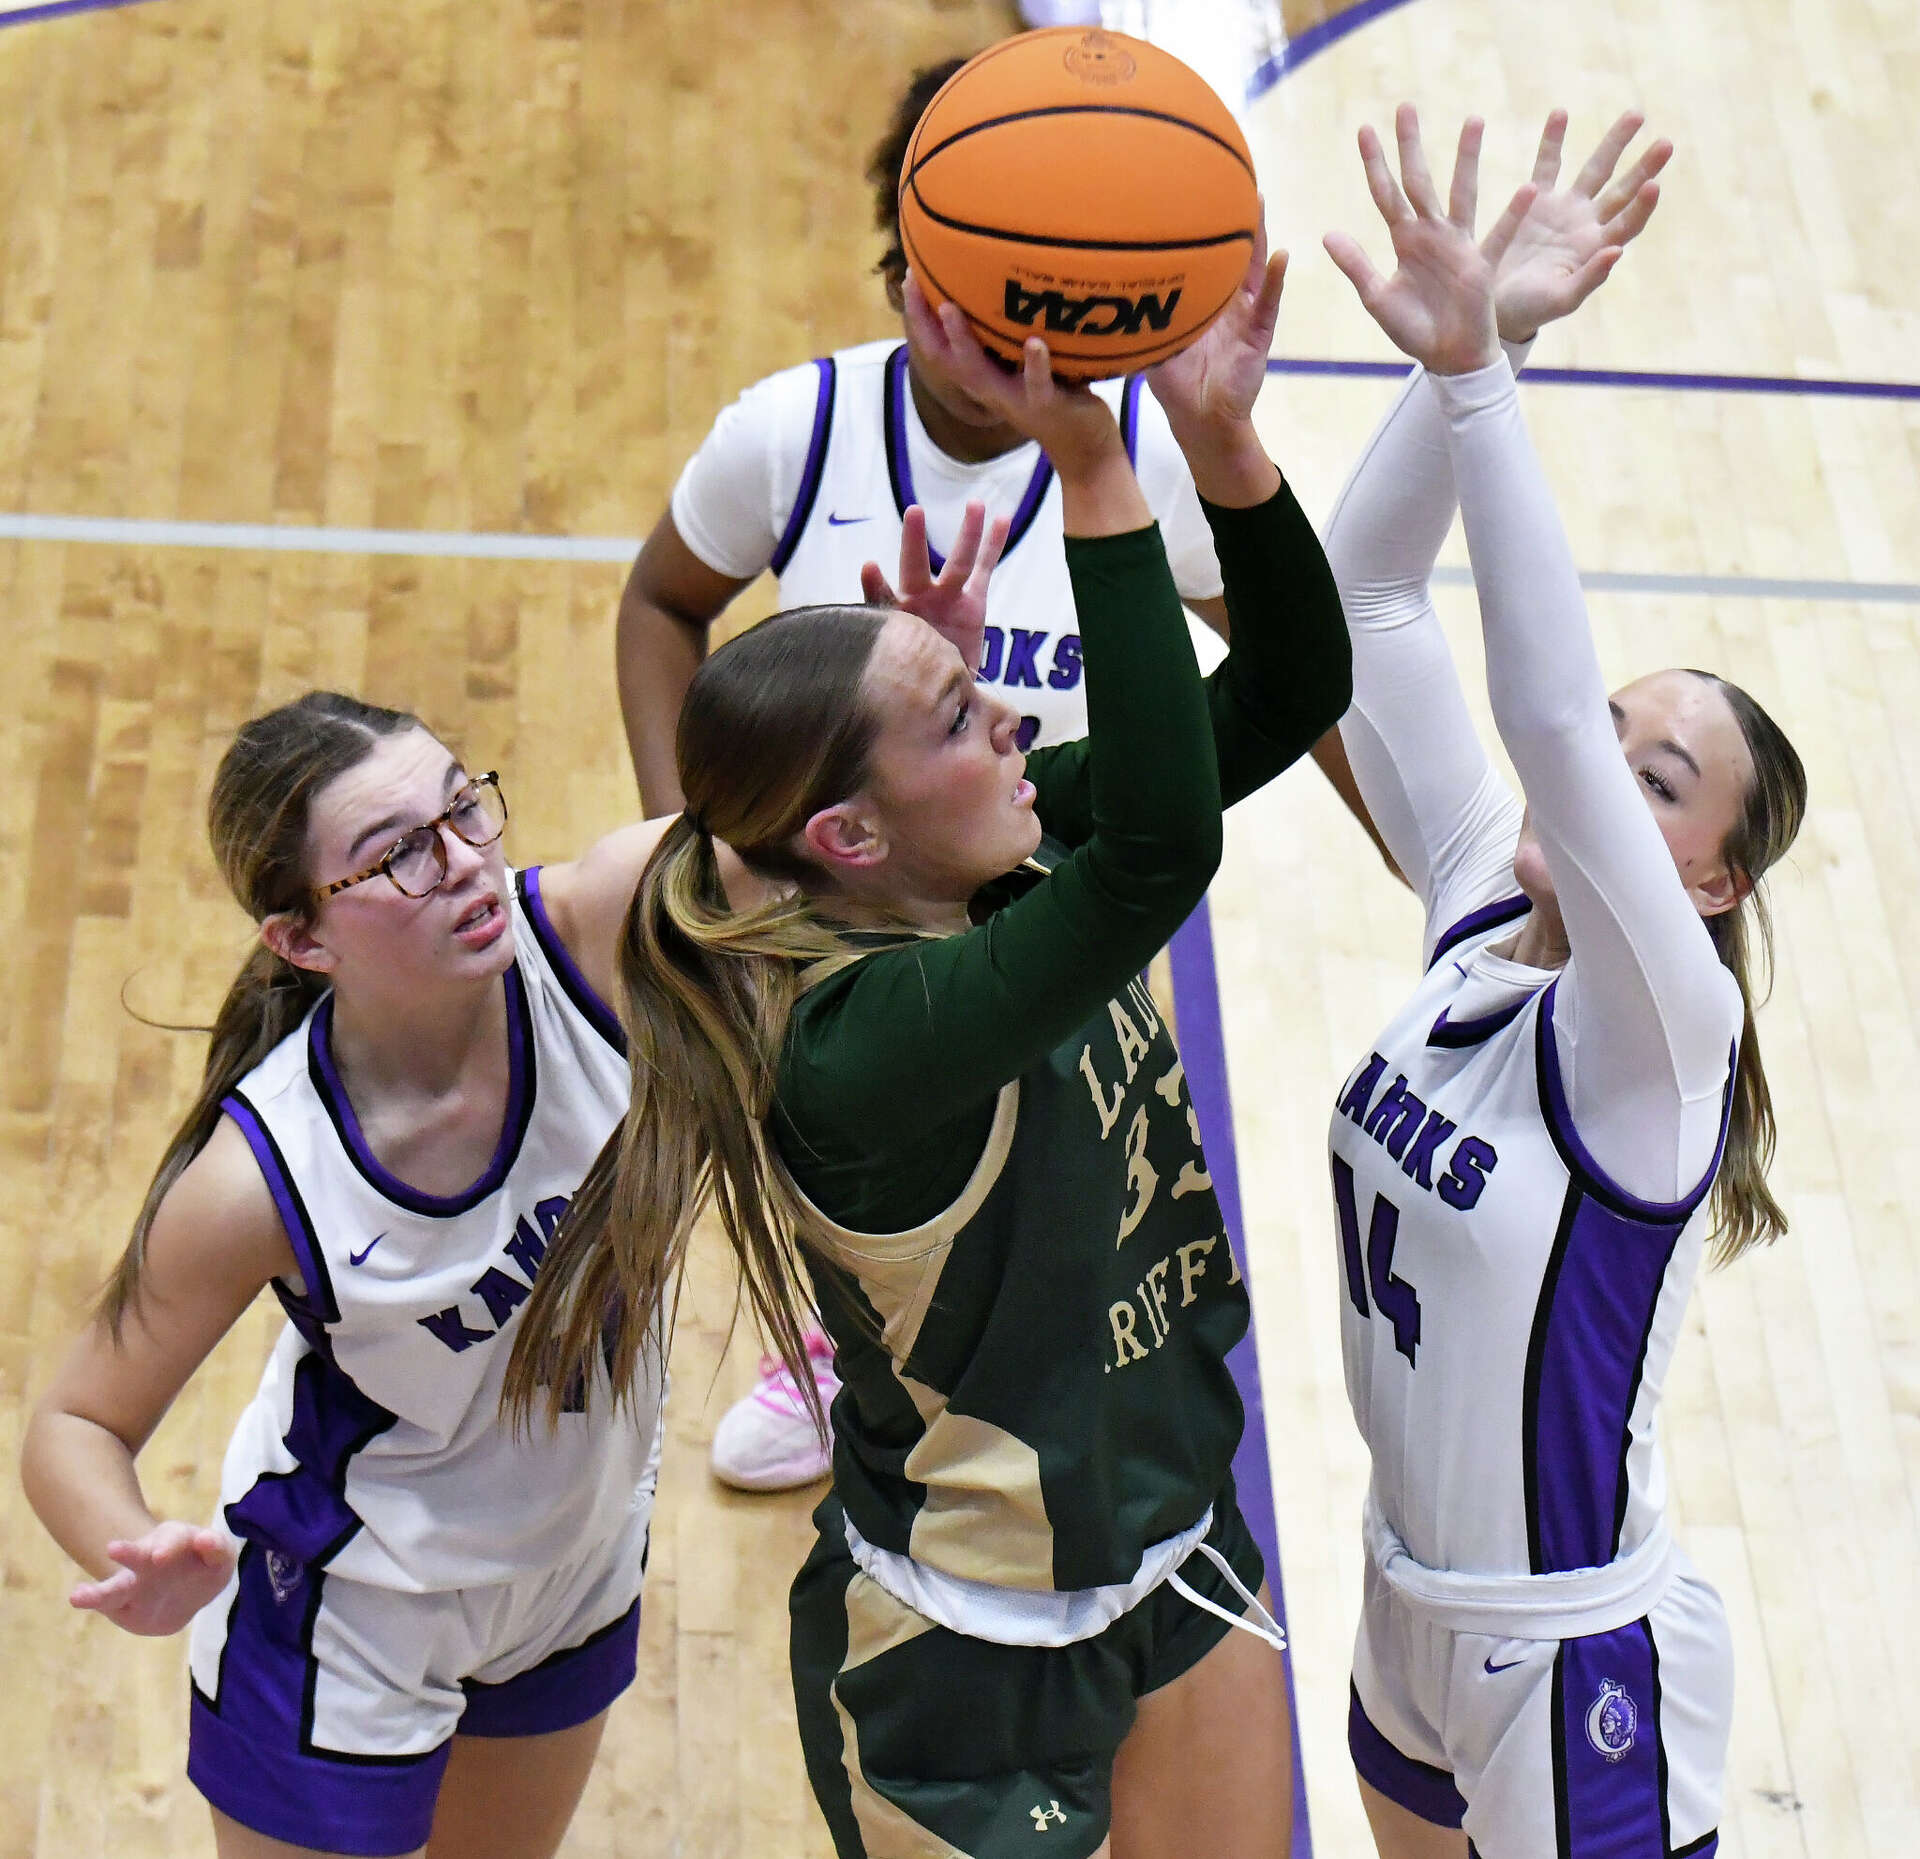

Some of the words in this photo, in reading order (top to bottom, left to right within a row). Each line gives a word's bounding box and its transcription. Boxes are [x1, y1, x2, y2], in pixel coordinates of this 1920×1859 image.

[1005, 278, 1182, 335] NCAA
[976, 626, 1083, 690] OKS
[1080, 974, 1159, 1141] LAD
[1336, 1051, 1498, 1211] AHOKS
[1104, 1225, 1241, 1374] RIFF
[1333, 1150, 1421, 1371] 14
